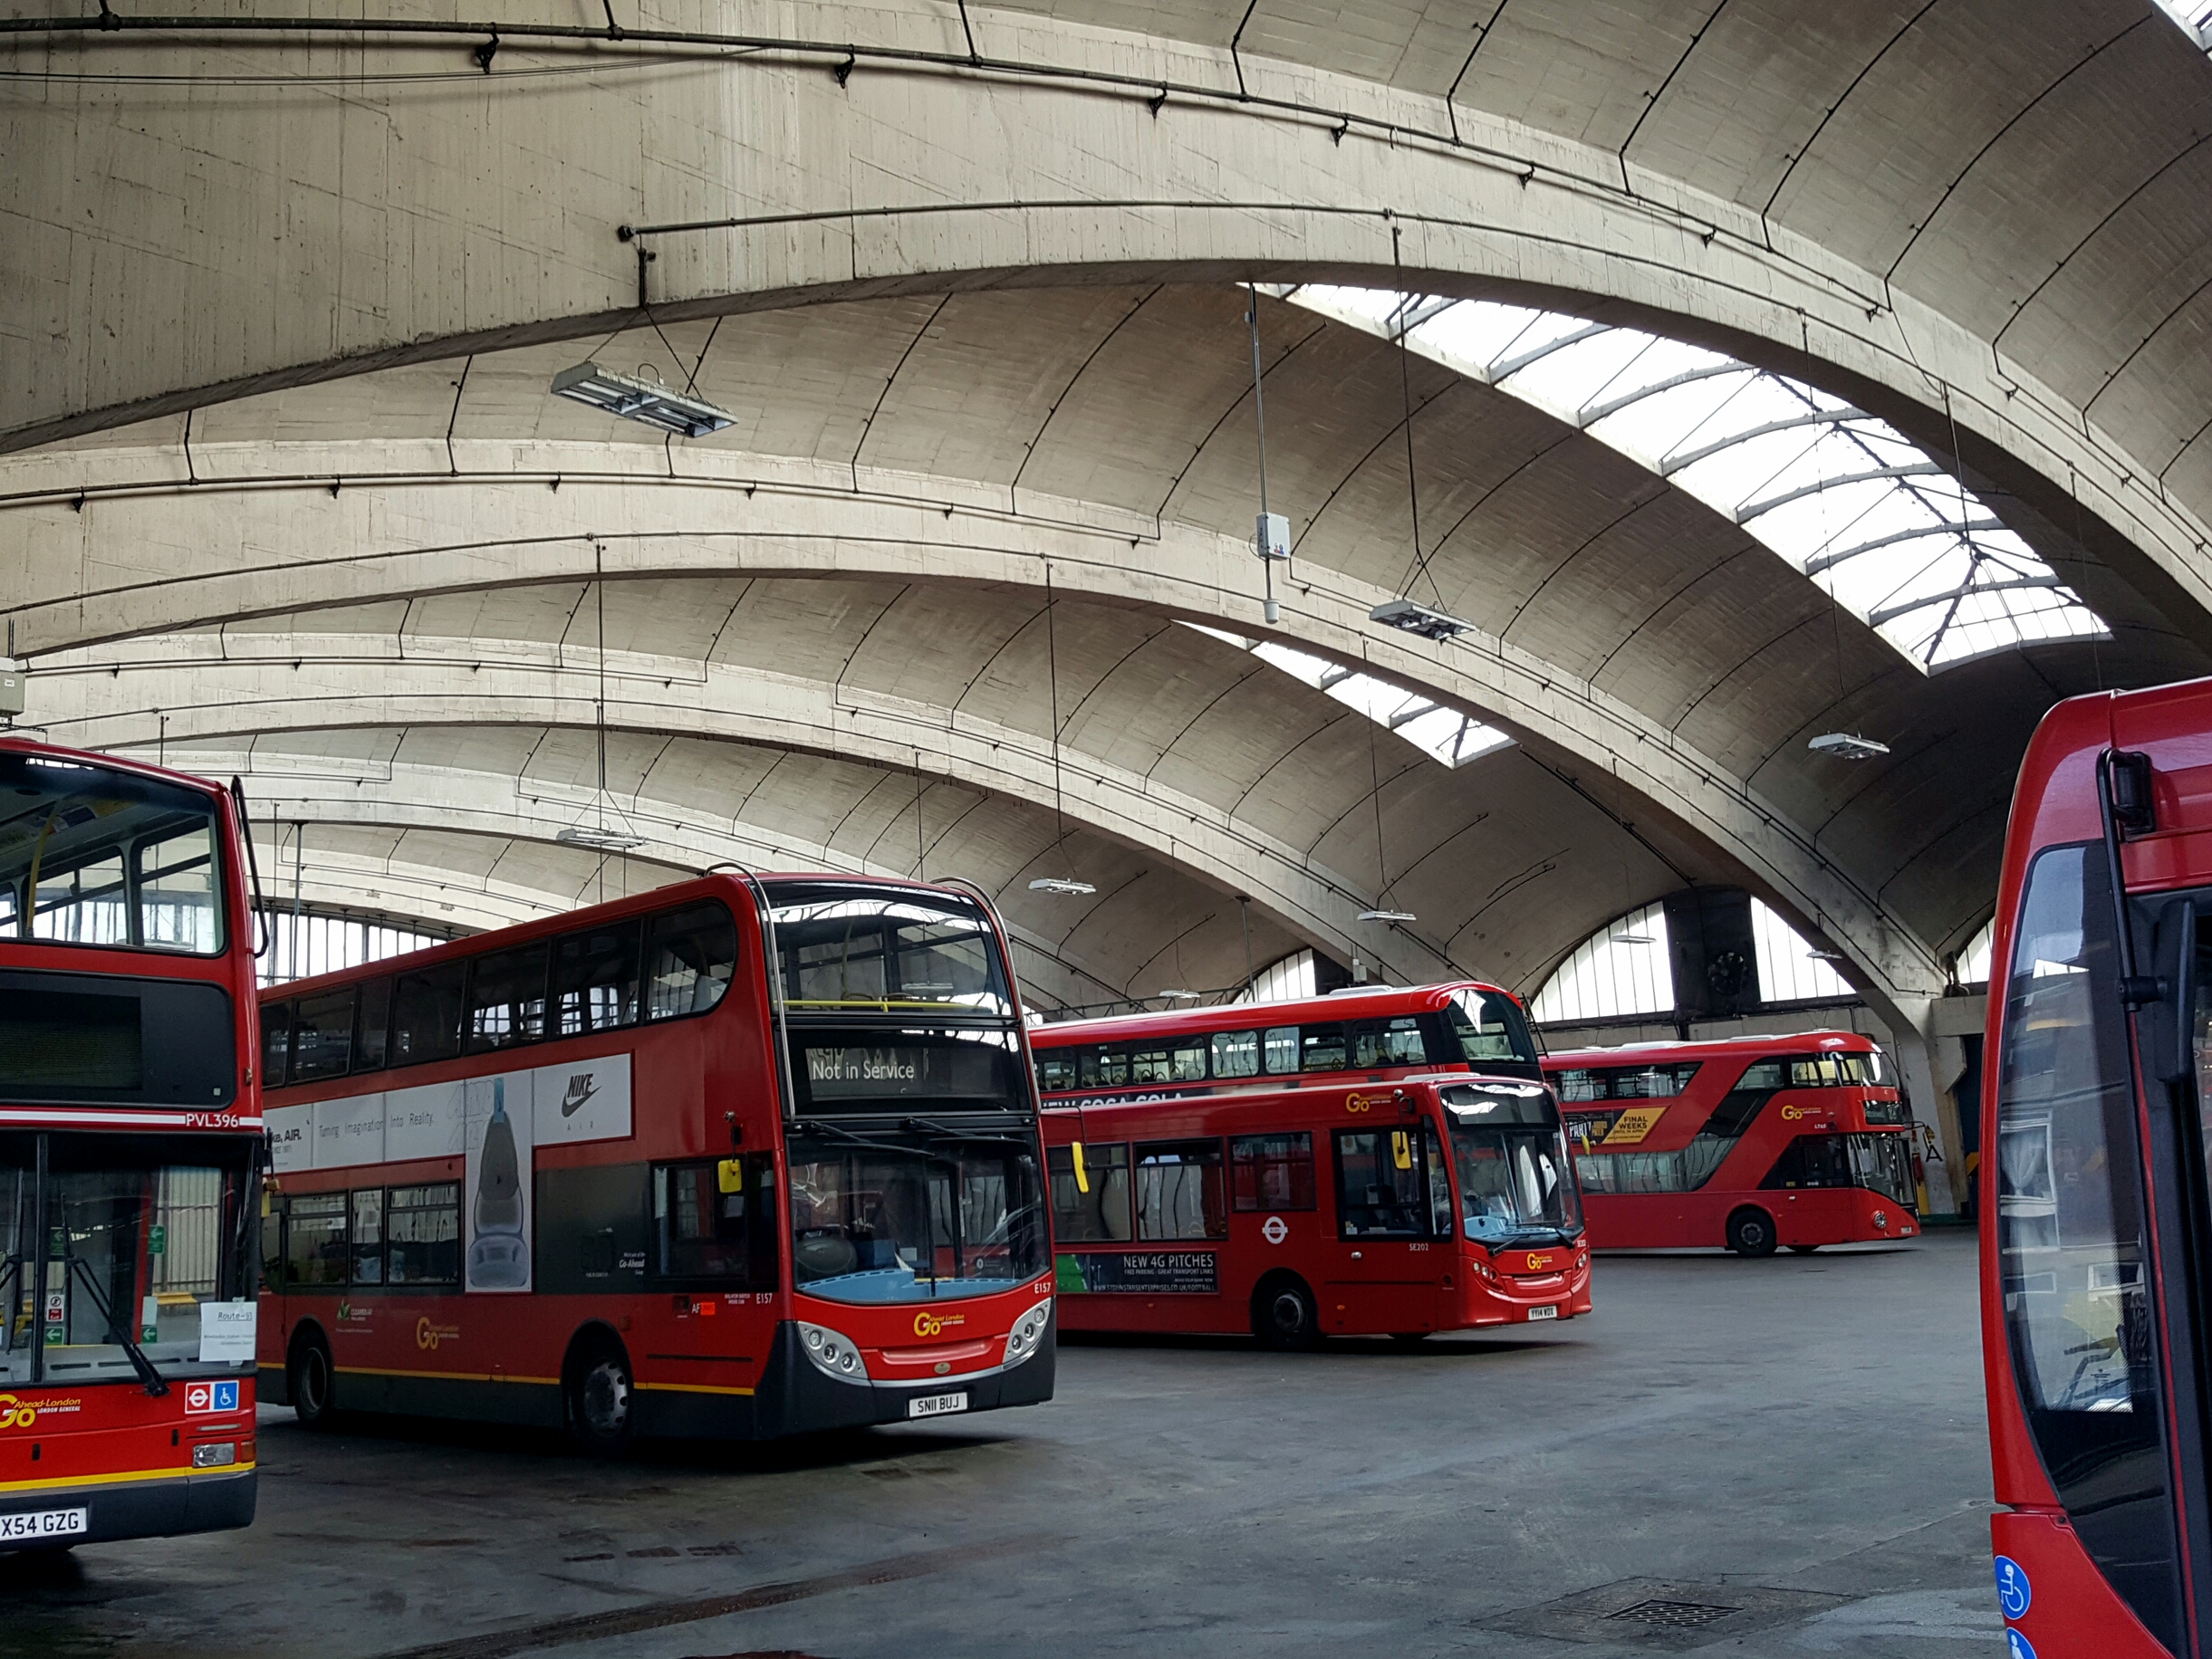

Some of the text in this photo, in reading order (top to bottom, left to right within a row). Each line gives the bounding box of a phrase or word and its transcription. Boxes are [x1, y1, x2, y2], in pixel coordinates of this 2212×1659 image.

[813, 1060, 914, 1079] Not in Service
[567, 1073, 593, 1098] NIKE
[186, 1113, 239, 1127] PVL396
[344, 1119, 384, 1136] Imagination
[390, 1116, 404, 1128] Into
[284, 1128, 302, 1141] AIR.
[1409, 1243, 1429, 1251] SE202
[1123, 1254, 1214, 1268] NEW 4G PITCHES
[1034, 1282, 1051, 1293] E157
[756, 1293, 773, 1304] E157
[918, 1395, 959, 1413] SN11 BUJ
[2, 1512, 78, 1537] X54 GZG
